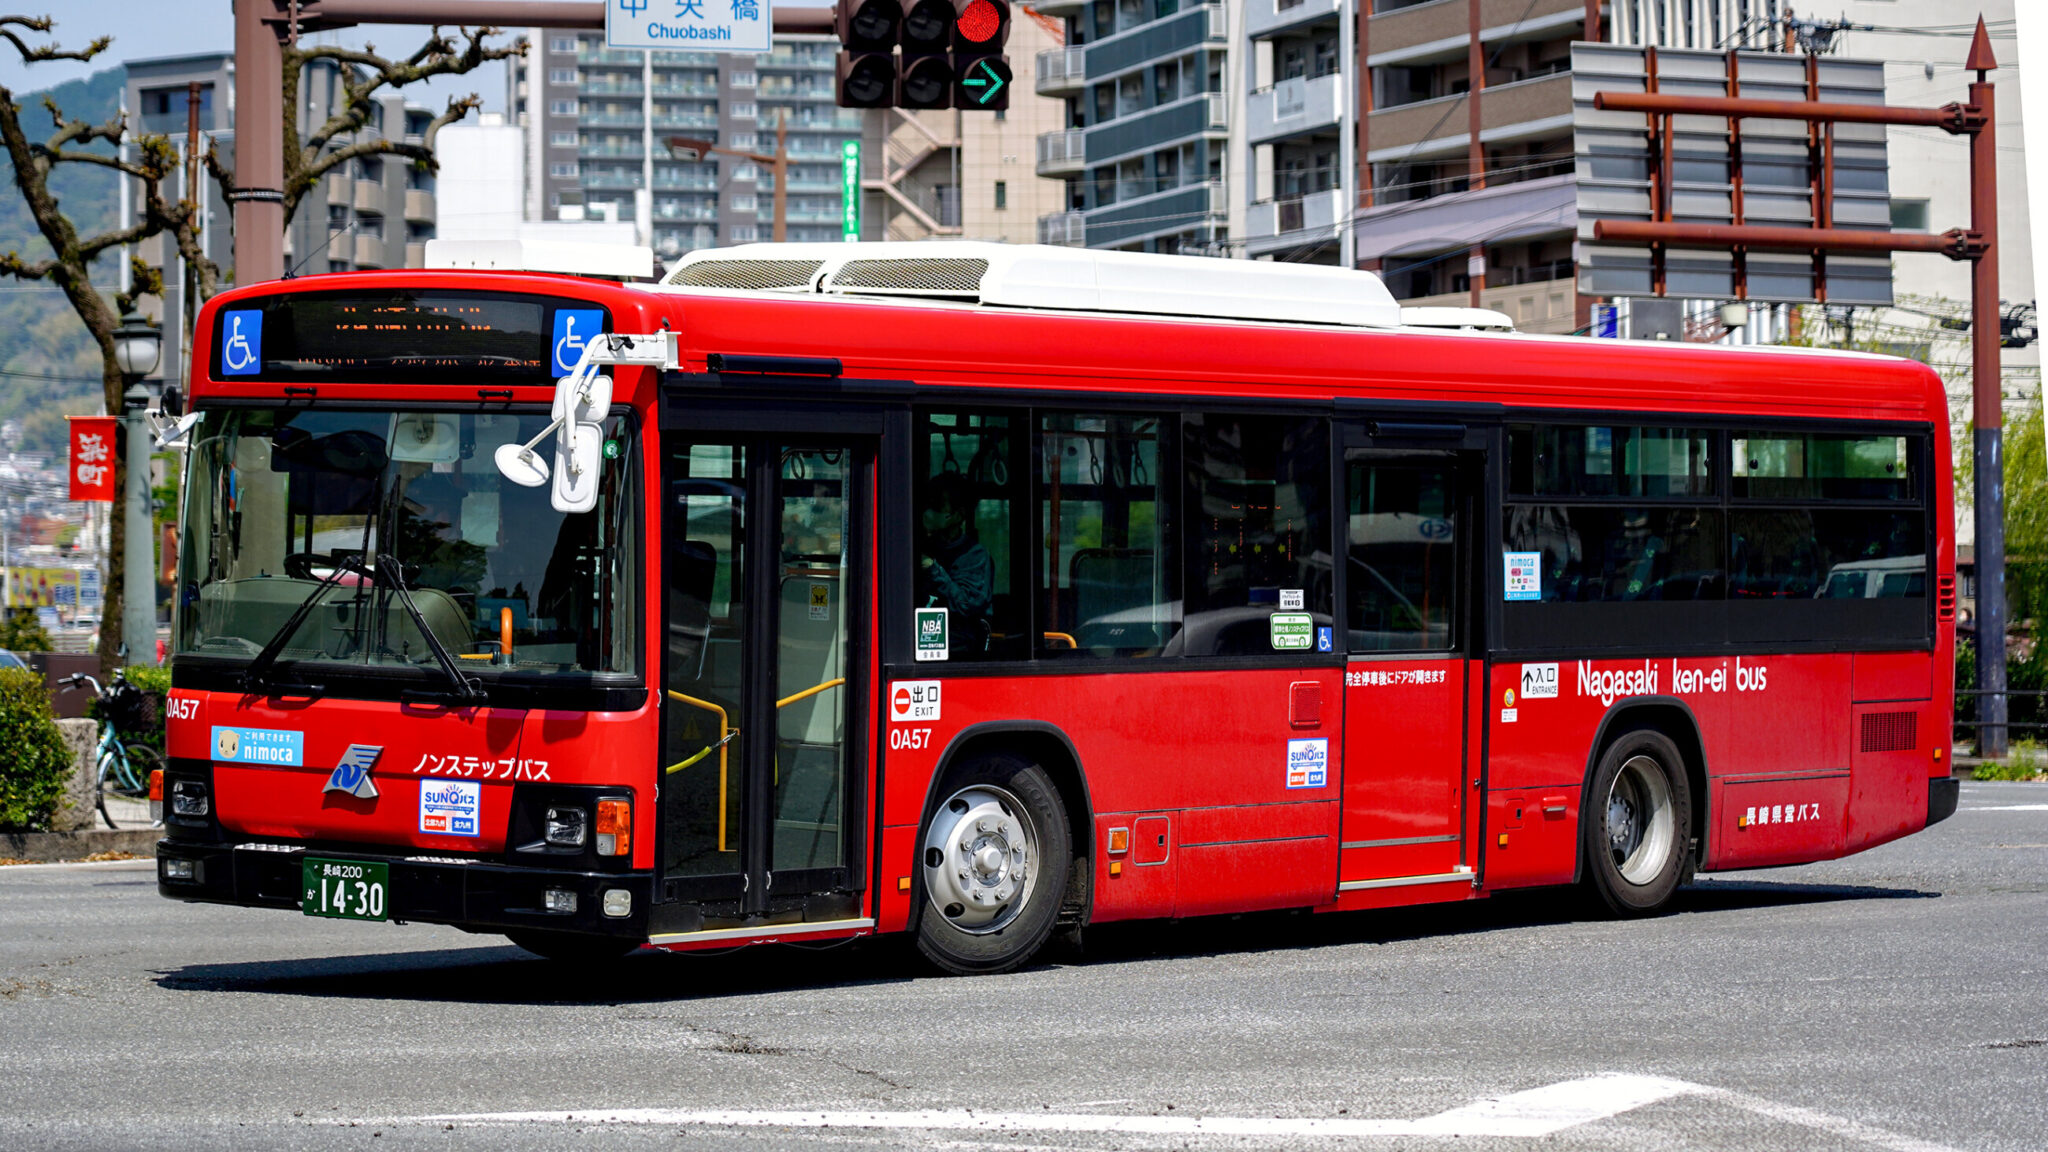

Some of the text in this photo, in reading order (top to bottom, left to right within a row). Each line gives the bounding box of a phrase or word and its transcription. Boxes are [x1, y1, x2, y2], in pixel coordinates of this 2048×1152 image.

[647, 22, 731, 40] Chuobashi
[922, 620, 942, 632] NBA
[1345, 669, 1446, 687] 完全停車後にドアが開きます
[1536, 668, 1555, 683] 入口
[1578, 656, 1767, 707] Nagasaki ken-ei bus
[913, 685, 938, 703] 出口
[1532, 685, 1557, 695] ENTRANCE
[915, 706, 934, 716] EXIT
[244, 741, 293, 762] nimoca
[413, 754, 551, 781] ノンステップバス
[1746, 803, 1820, 826] 長崎県営バス
